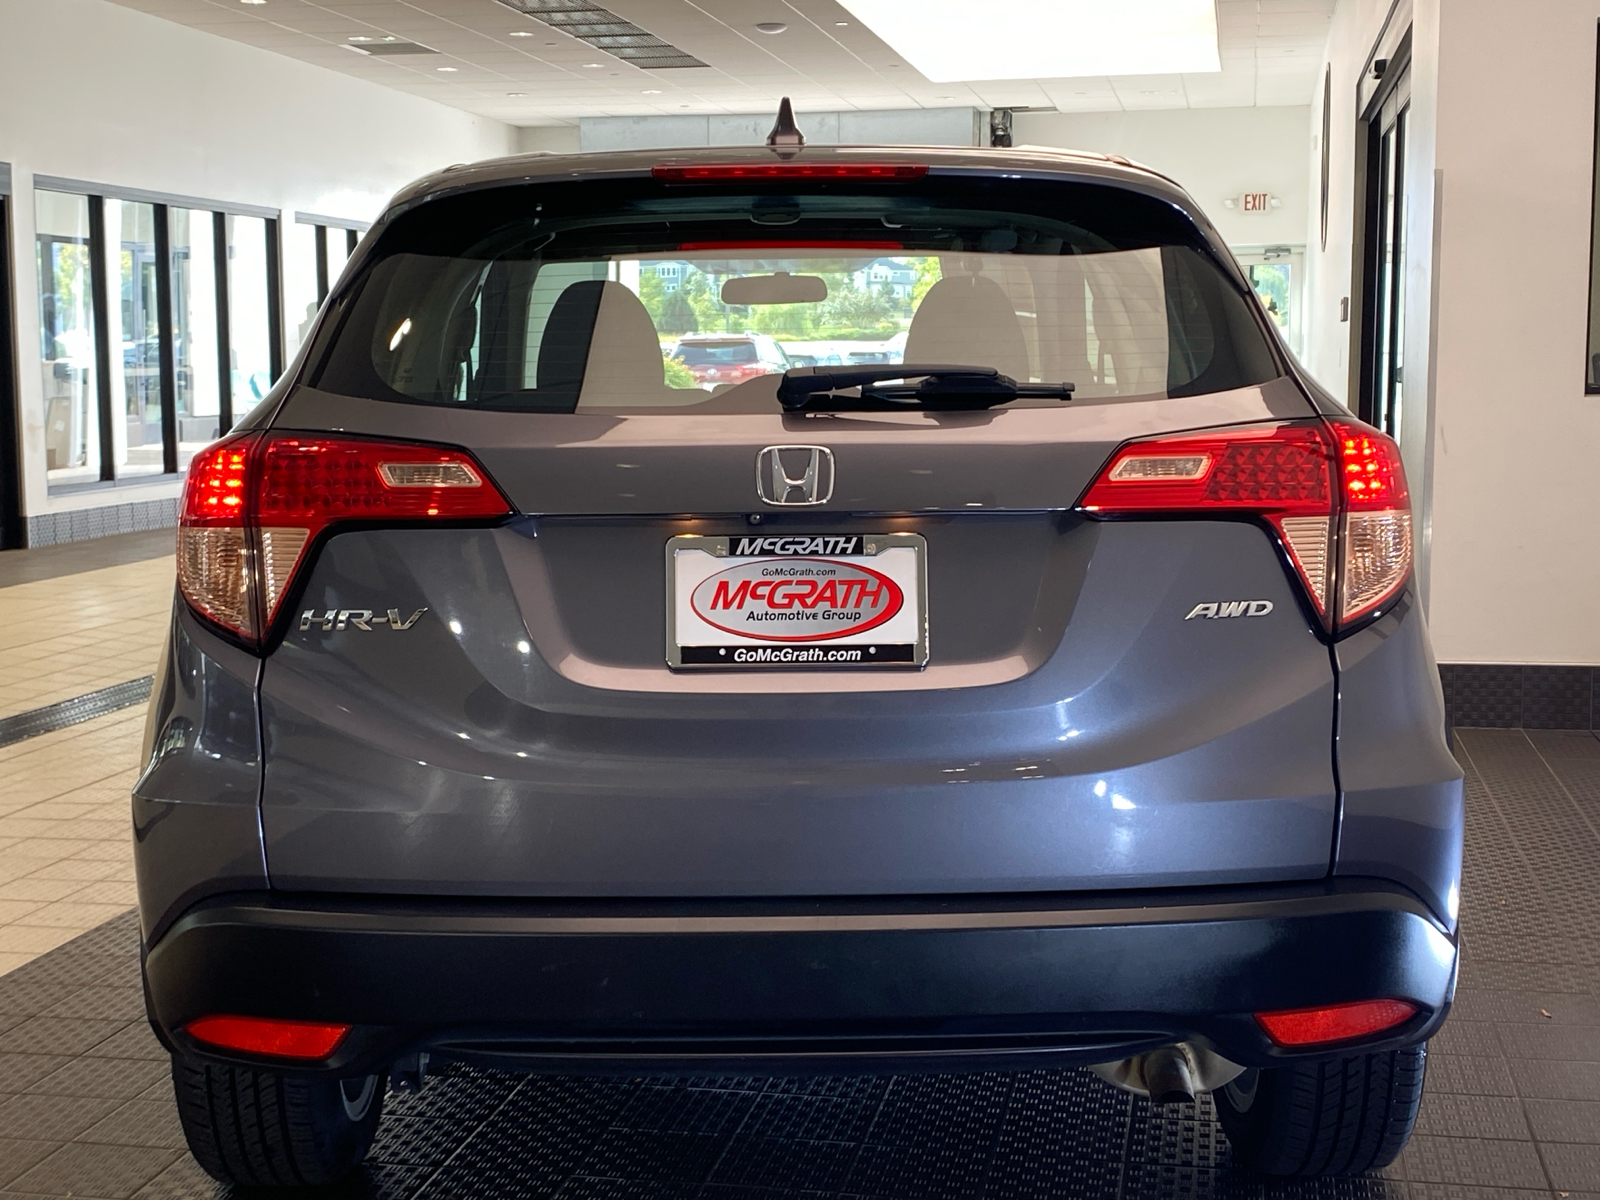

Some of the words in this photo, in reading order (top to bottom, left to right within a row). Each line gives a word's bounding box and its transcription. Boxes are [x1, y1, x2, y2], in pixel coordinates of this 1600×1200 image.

[1244, 193, 1268, 211] EXIT
[761, 567, 836, 577] GoMcGrath.com
[746, 610, 819, 622] Automotive
[822, 610, 862, 622] Group
[1185, 600, 1274, 620] AWD
[299, 607, 429, 631] HR-V
[733, 648, 862, 662] GoMcGrath.com
